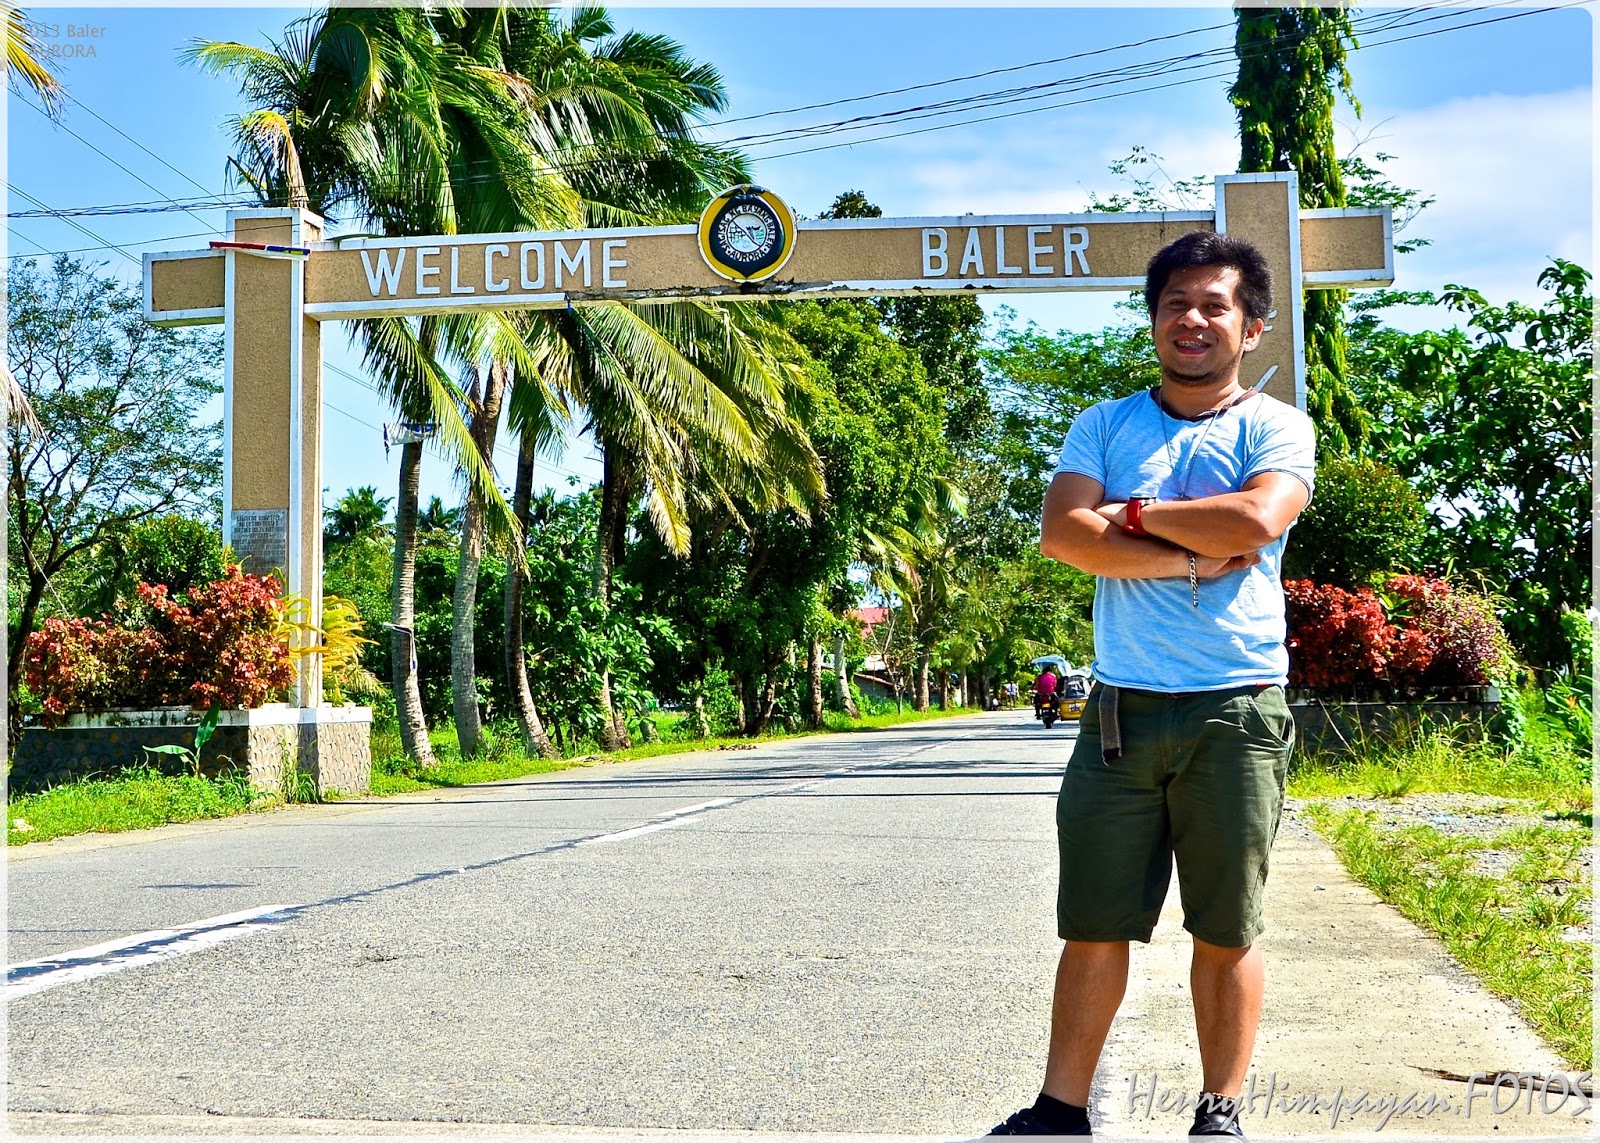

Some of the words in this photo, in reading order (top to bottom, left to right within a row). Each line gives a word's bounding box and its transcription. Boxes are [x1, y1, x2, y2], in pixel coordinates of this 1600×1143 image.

[765, 221, 775, 248] BALER
[922, 226, 1091, 277] BALER
[360, 240, 627, 296] WELCOME
[730, 250, 764, 261] AURORA
